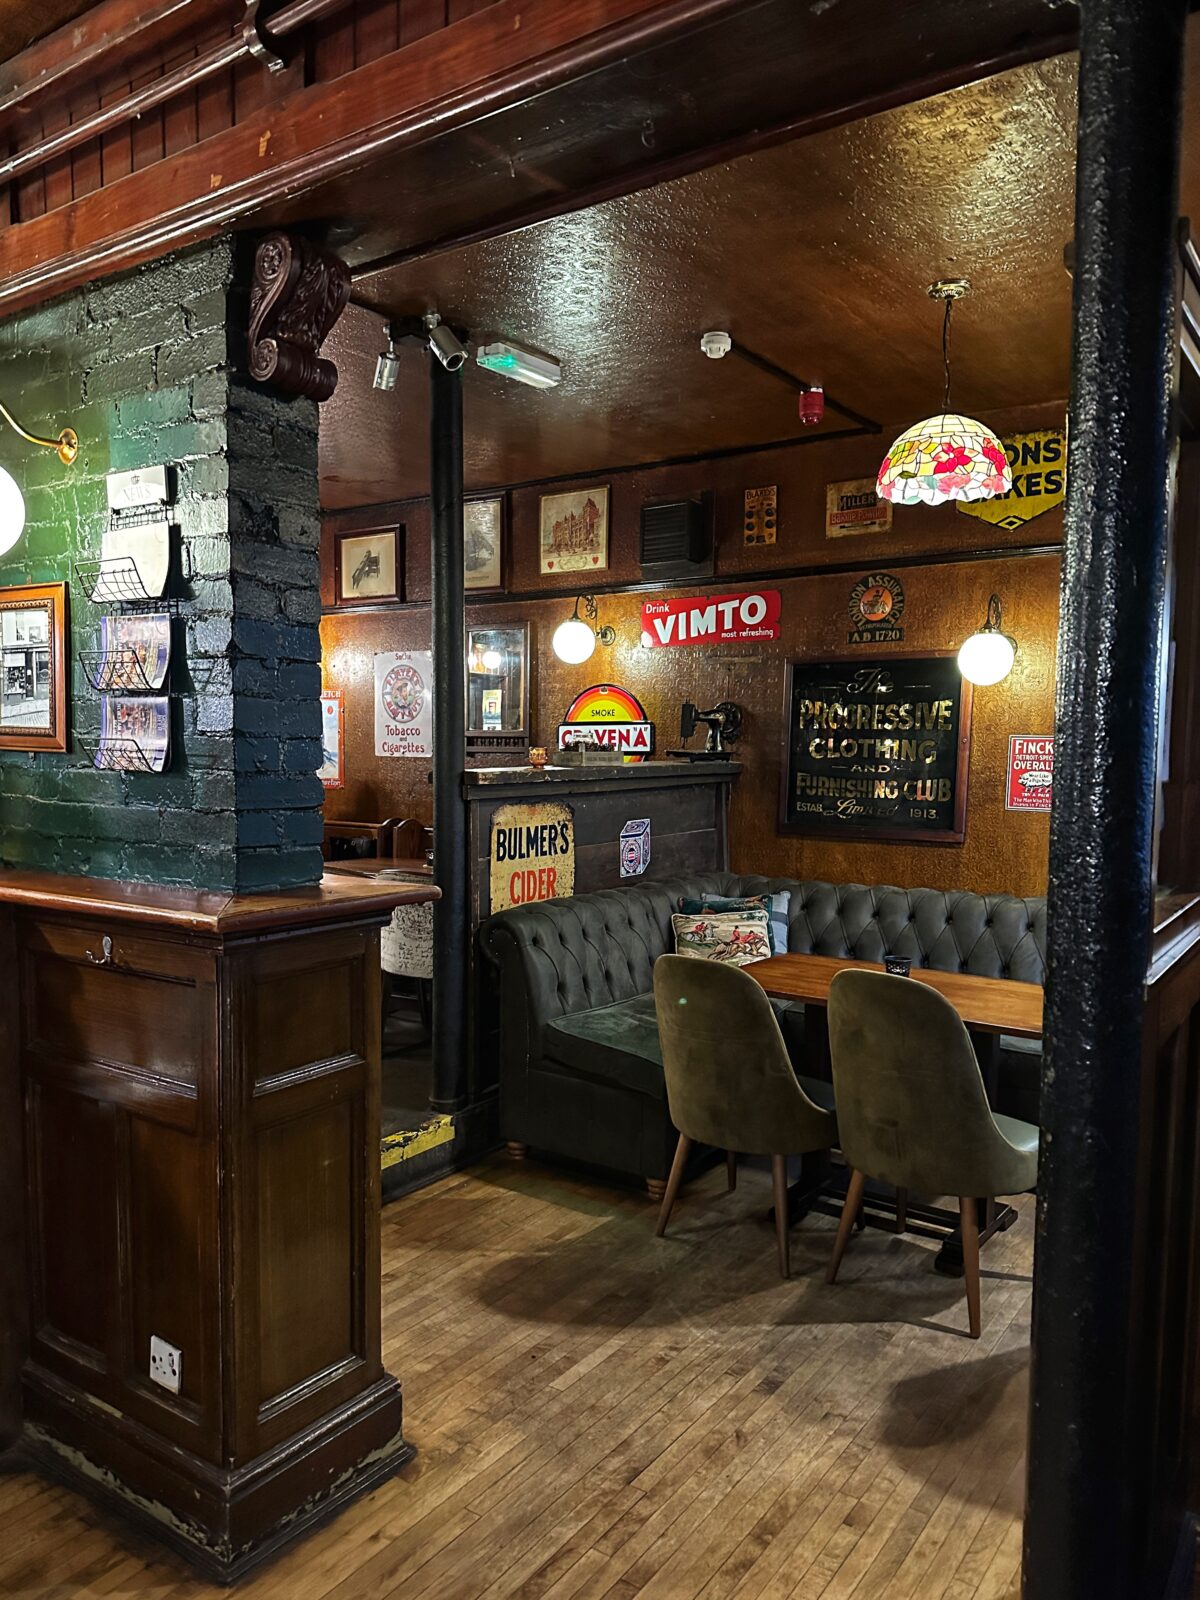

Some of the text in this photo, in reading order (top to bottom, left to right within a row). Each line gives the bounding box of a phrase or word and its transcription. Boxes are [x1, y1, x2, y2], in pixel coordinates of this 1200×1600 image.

[645, 603, 670, 614] Drink
[849, 575, 904, 628] LONDON ASSURANCE
[652, 594, 767, 645] VIMTO
[721, 626, 774, 639] most refreshing
[846, 667, 895, 694] The
[591, 709, 615, 717] SMOKE
[799, 698, 954, 731] PROGRESSIVE
[385, 725, 421, 736] Tobacco
[561, 728, 631, 748] CVEN
[382, 741, 425, 756] Cigarettes
[809, 737, 938, 765] CLOTHING
[1015, 740, 1054, 754] FINCK
[850, 764, 892, 773] AND
[796, 771, 953, 802] FURNISHING CLUB
[496, 820, 569, 862] BULMER'S
[509, 867, 557, 905] CIDER
